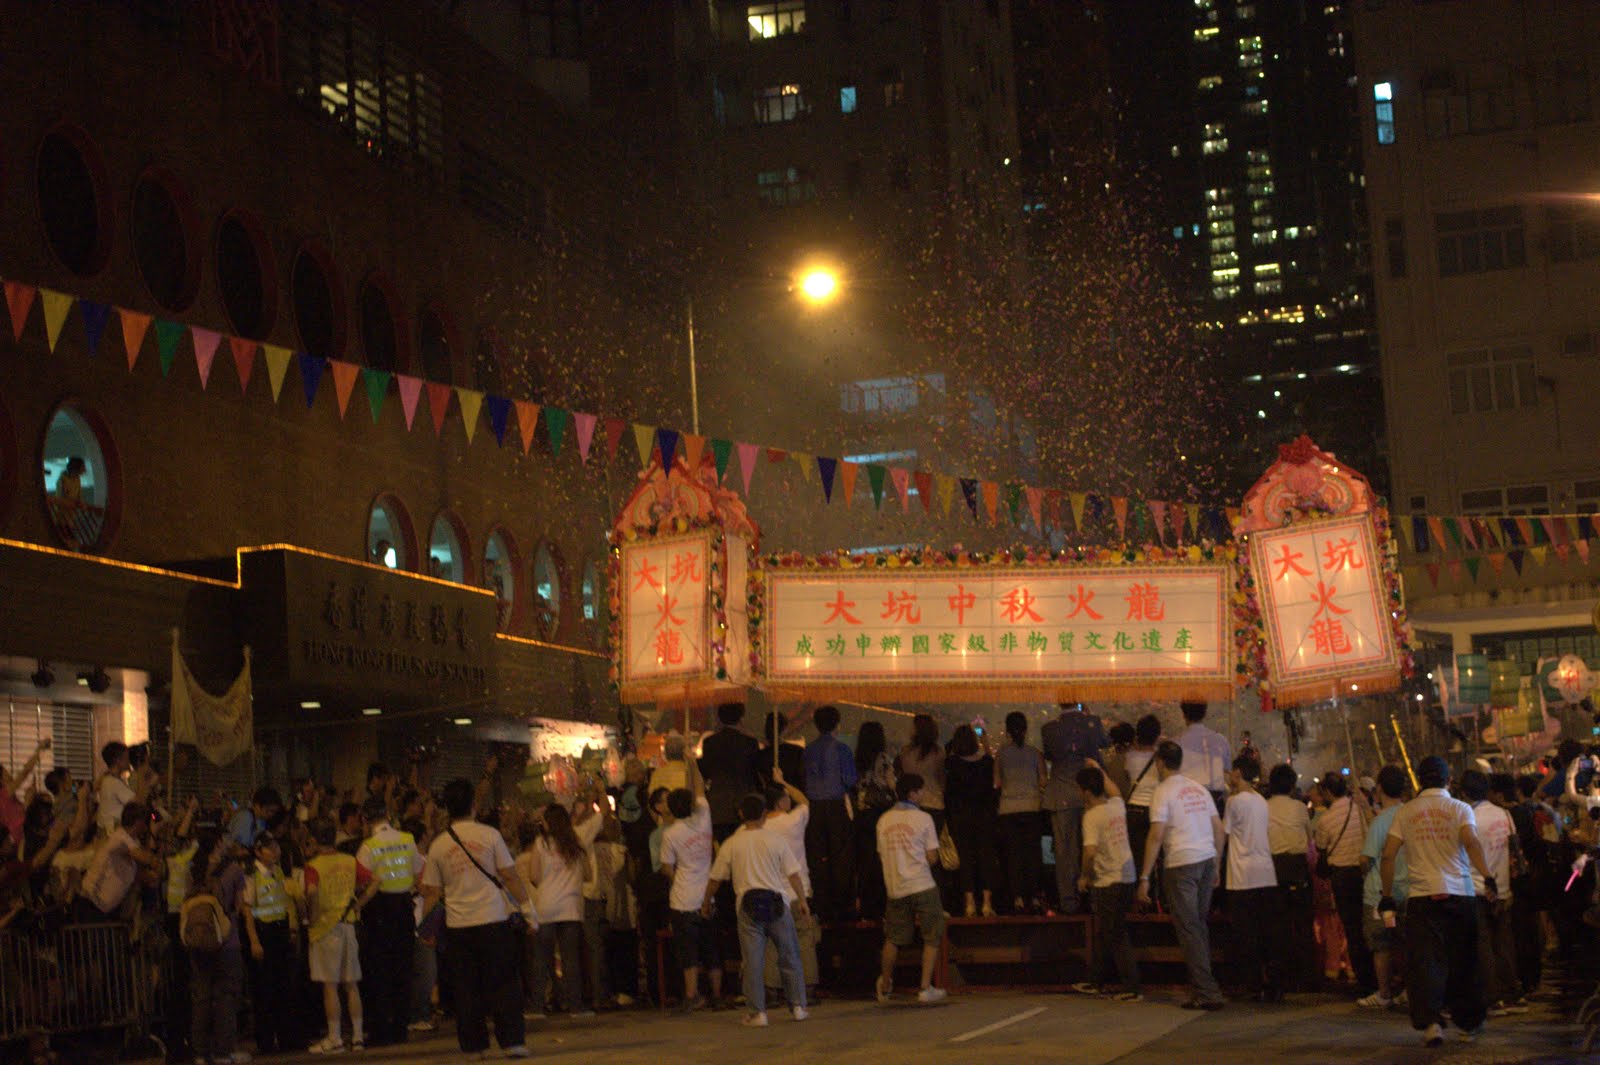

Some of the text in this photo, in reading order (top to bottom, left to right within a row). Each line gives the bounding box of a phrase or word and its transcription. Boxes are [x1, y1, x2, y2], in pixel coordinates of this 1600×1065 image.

[633, 552, 702, 593] 大坑
[1273, 537, 1364, 582] 大坑
[822, 582, 1165, 625] 大坑中秋火龍
[1308, 580, 1353, 656] 火龍
[652, 594, 685, 666] 火龍
[796, 627, 1193, 658] 成功申辦國家級非物質文化遺產
[304, 639, 345, 665] HONG
